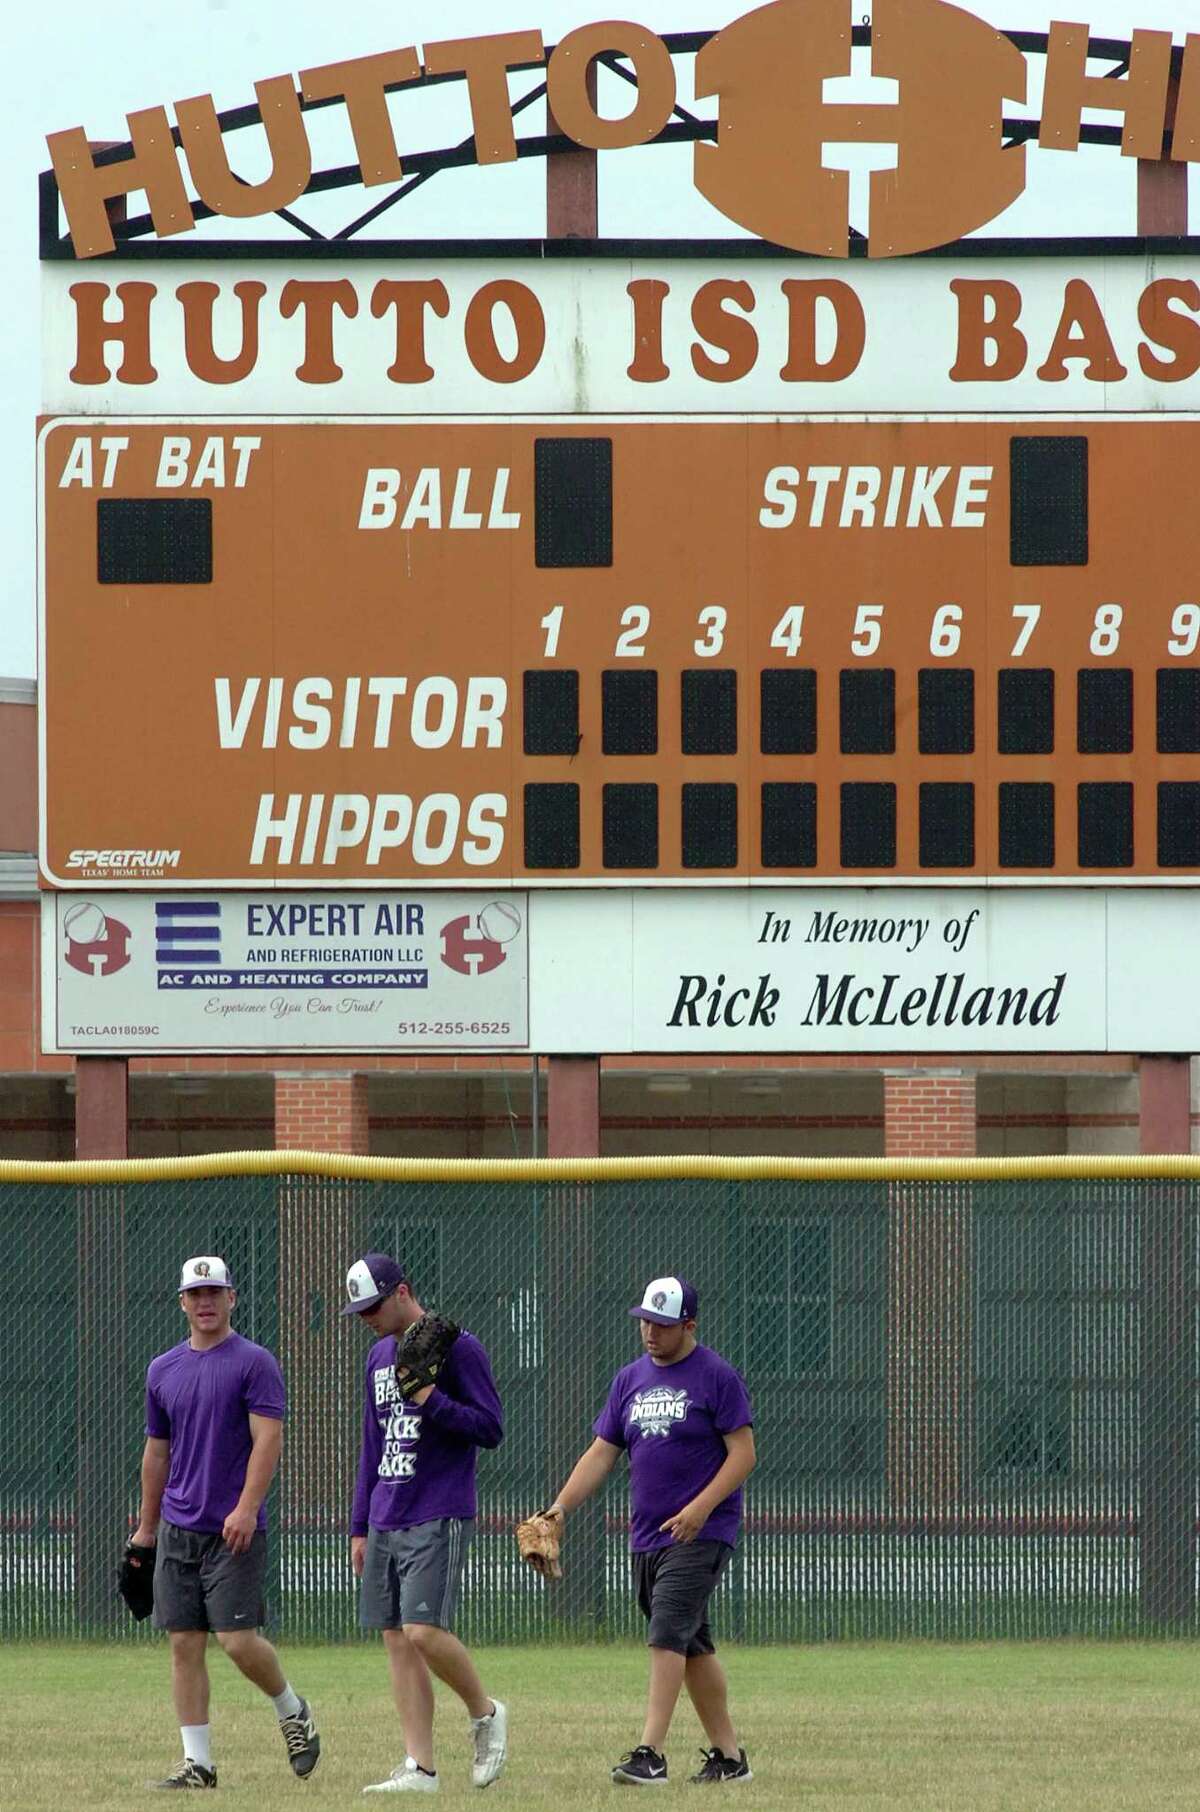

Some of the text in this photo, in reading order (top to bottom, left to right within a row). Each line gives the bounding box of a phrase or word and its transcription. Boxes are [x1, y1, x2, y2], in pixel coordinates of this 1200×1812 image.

[46, 20, 677, 258] HUTTO
[69, 278, 1200, 385] HUTTO ISD BAS
[58, 436, 262, 488] AT BAT
[358, 467, 522, 530] BALL
[758, 465, 994, 529] STRIKE
[541, 604, 1200, 658] 1 2 3 4 5 6 7 8 9
[214, 676, 508, 750] VISITOR
[249, 793, 508, 866] HIPPOS
[64, 849, 181, 868] SPECTRUM
[112, 868, 138, 877] HOME
[141, 868, 164, 877] TEAM
[247, 903, 424, 937] EXPERT AIR
[757, 910, 980, 953] In Memory of
[159, 973, 425, 985] AC AND HEATING COMPANY
[246, 948, 423, 963] AND REFRIGERATION LLC
[204, 997, 266, 1017] Experience
[270, 996, 302, 1019] You
[306, 997, 332, 1014] Can
[666, 972, 1067, 1028] Rick McLelland
[398, 1022, 511, 1035] 512-255-6525
[630, 1402, 685, 1421] INDIANS
